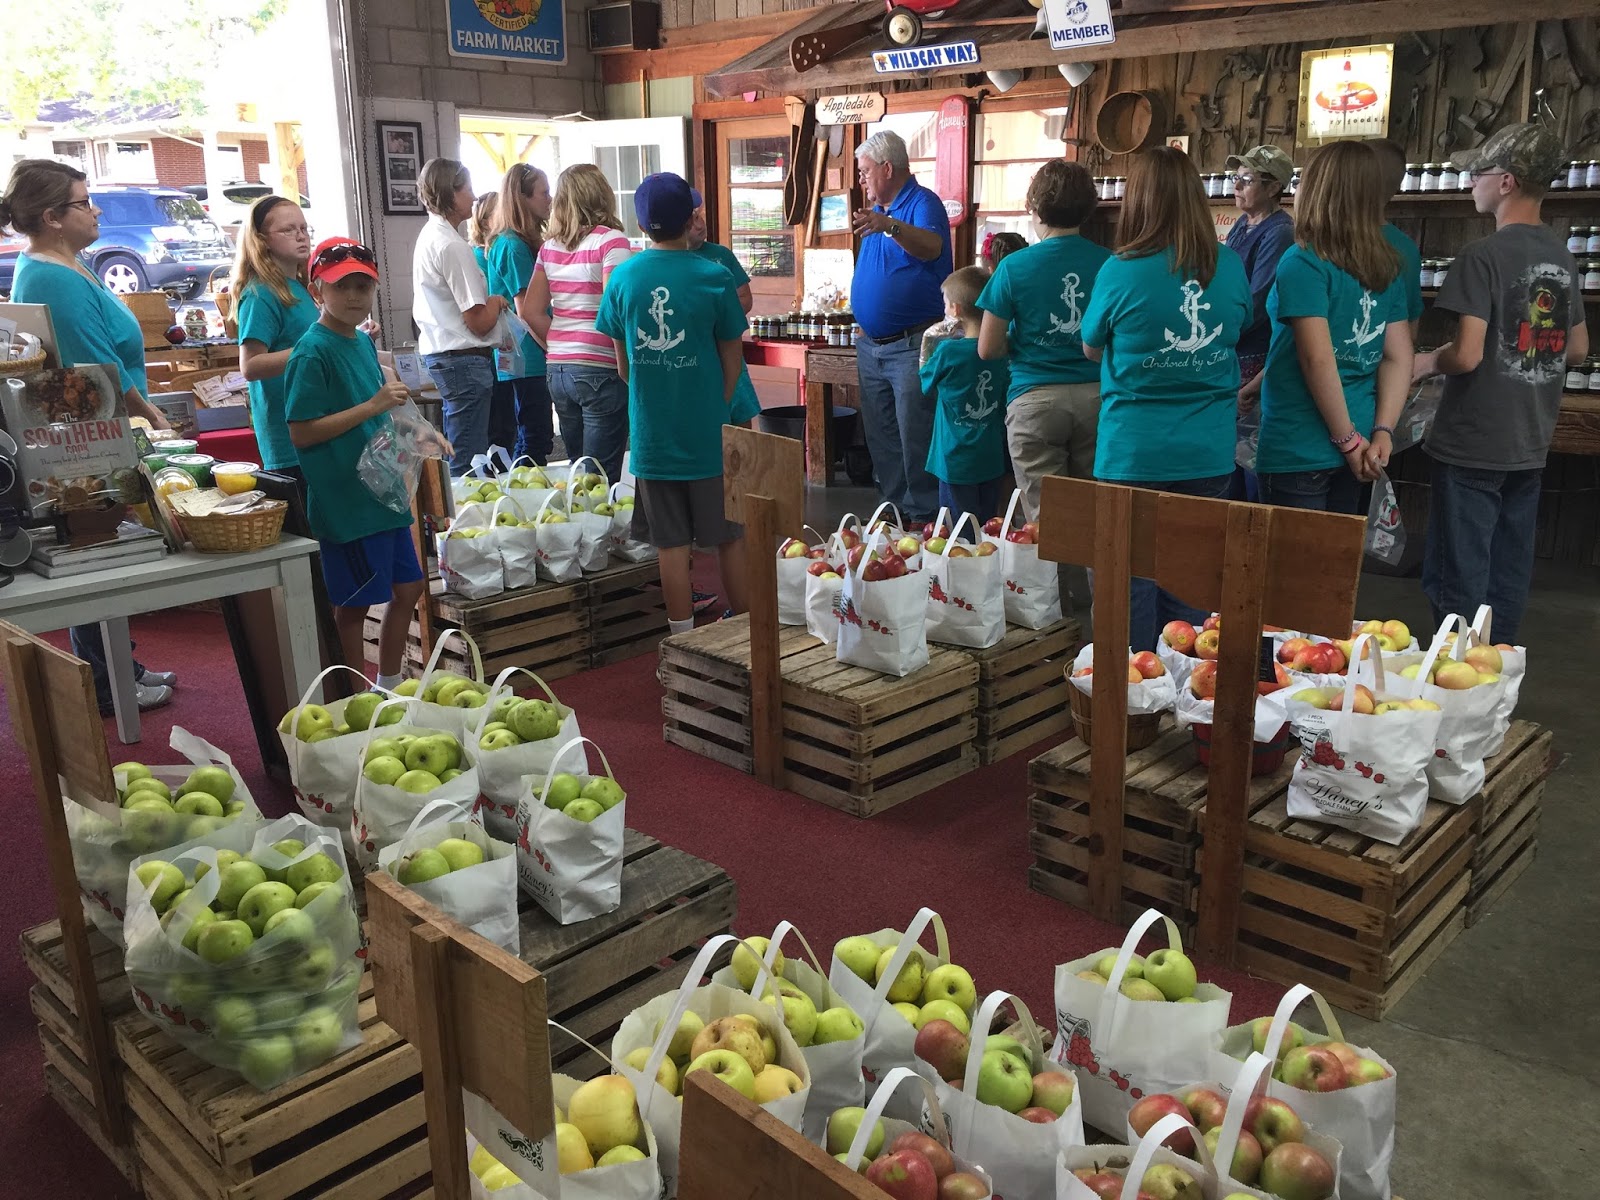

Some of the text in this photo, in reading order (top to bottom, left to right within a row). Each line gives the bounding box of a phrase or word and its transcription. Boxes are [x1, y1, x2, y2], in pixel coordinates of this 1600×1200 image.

[489, 14, 527, 29] CERTIFIED
[1053, 24, 1110, 42] MEMBER
[456, 29, 560, 56] FARM MARKET
[888, 44, 973, 69] WILDCAT WAY
[823, 94, 874, 112] Appledale
[835, 110, 863, 123] Farms
[1215, 213, 1237, 226] Han
[629, 353, 698, 372] Anchored by Faith
[1142, 354, 1190, 369] Anchored
[1192, 355, 1205, 372] by
[61, 412, 78, 423] The
[23, 419, 123, 450] SOUTHERN
[1304, 778, 1384, 815] Haney's
